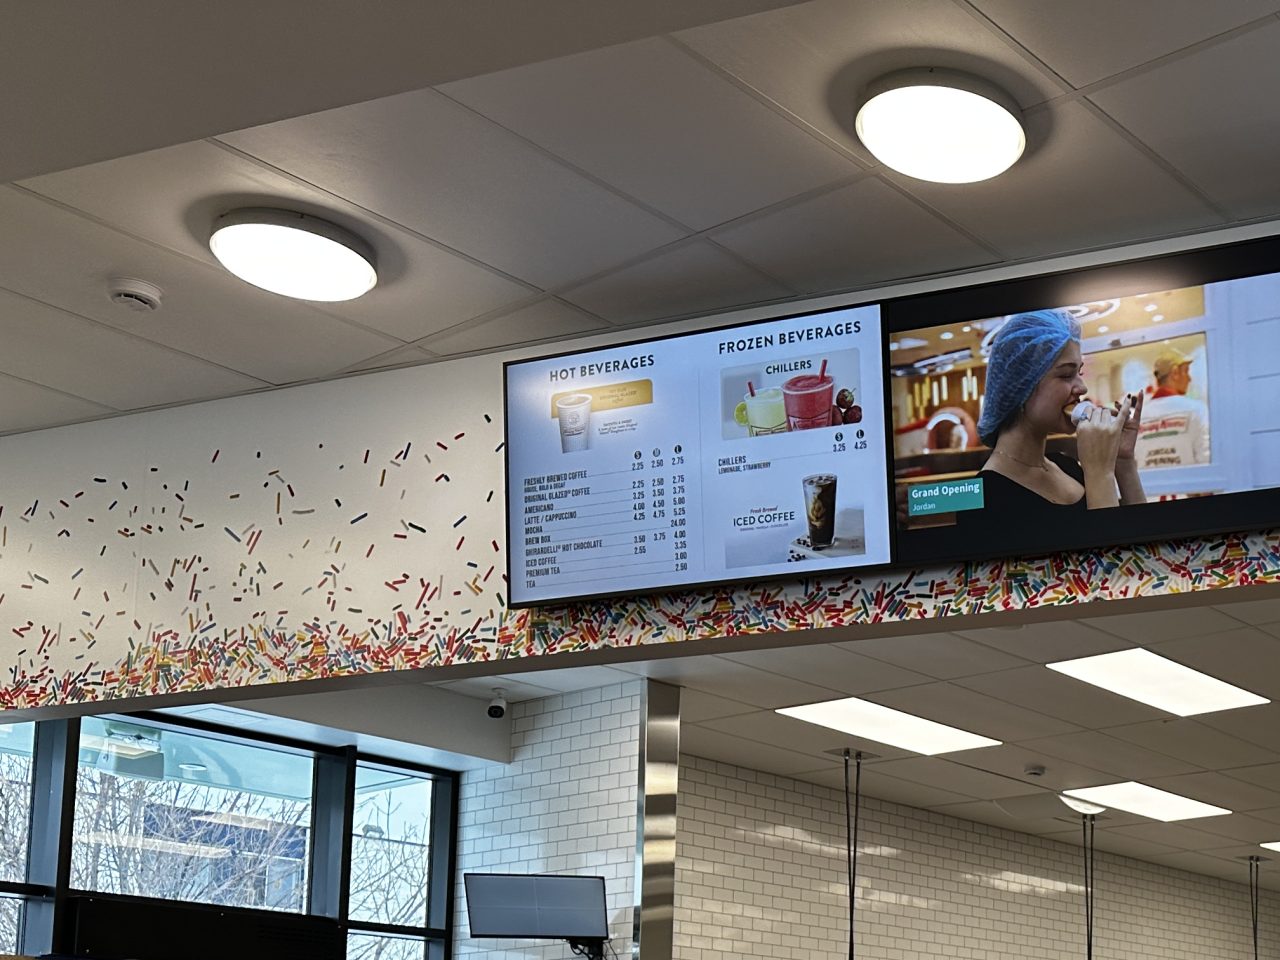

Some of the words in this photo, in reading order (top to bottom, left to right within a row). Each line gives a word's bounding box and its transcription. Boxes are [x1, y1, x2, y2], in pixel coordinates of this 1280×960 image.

[719, 335, 773, 355] FROZEN
[779, 321, 861, 345] BEVERAGES
[550, 367, 576, 381] HOT
[580, 354, 654, 376] BEVERAGES
[765, 360, 812, 375] CHILLERS
[833, 443, 846, 452] 3.25
[854, 440, 867, 450] 4.25
[718, 455, 746, 467] CHILLERS
[912, 486, 939, 498] Grand
[941, 483, 980, 496] Opening
[913, 503, 936, 511] Jordan
[733, 516, 756, 527] ICED
[757, 511, 795, 524] COFFEE
